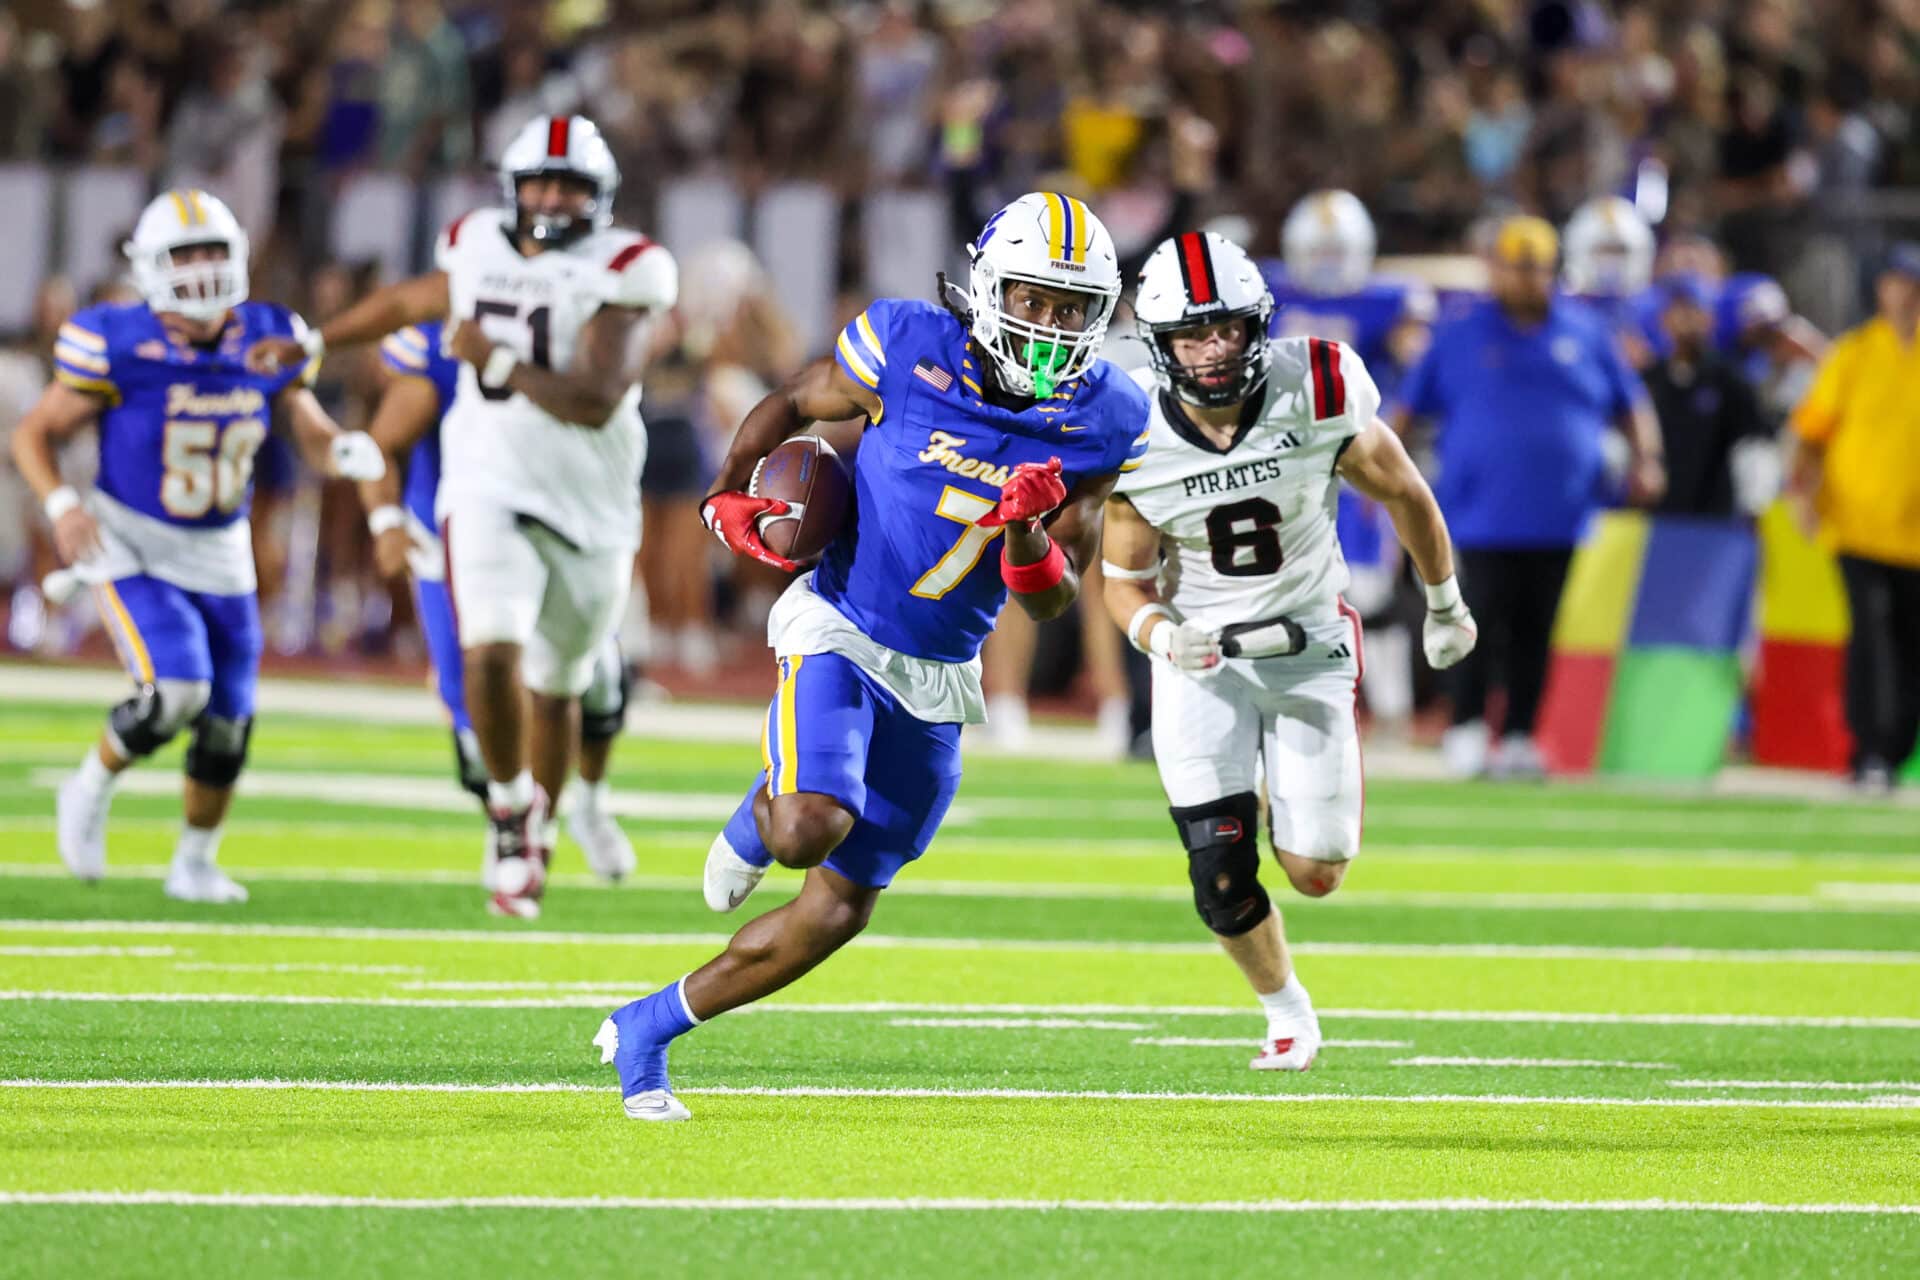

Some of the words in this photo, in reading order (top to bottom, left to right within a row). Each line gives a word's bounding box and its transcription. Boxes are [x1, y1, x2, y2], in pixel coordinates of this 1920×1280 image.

[1050, 260, 1086, 273] FRENSHIP
[160, 418, 267, 519] 50
[918, 430, 1019, 488] Frens
[1182, 457, 1281, 497] PIRATES
[908, 484, 1007, 601] 7
[1204, 496, 1285, 577] 6
